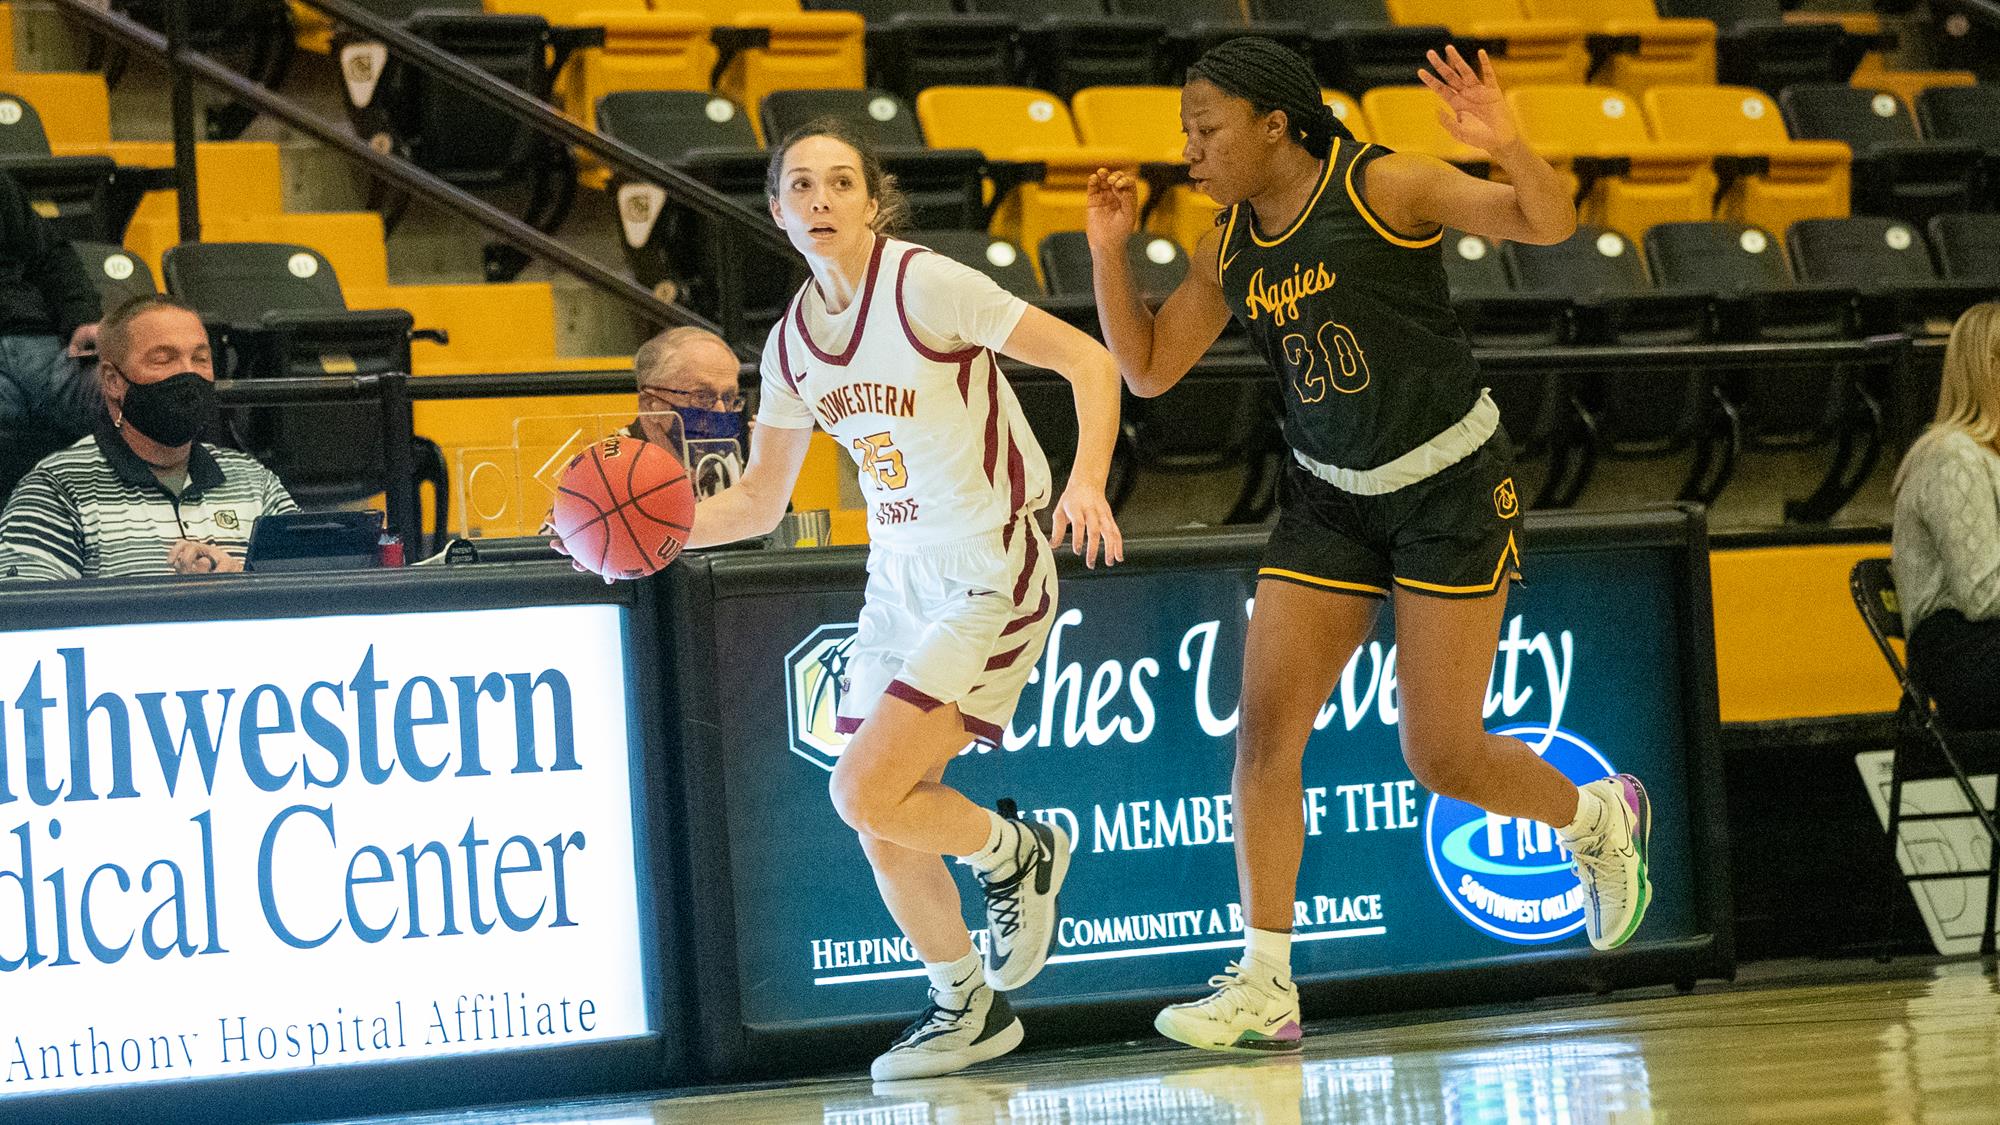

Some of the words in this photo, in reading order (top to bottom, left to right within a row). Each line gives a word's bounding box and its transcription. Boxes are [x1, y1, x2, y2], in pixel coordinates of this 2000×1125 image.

[1245, 261, 1336, 327] Aggies
[1282, 320, 1370, 403] 20
[853, 431, 909, 491] 15
[876, 498, 919, 525] STATE
[0, 643, 583, 806] thwestern
[1092, 793, 1236, 853] MEMBE
[1302, 786, 1327, 836] F
[1335, 779, 1419, 833] THE
[257, 802, 587, 950] Center
[1057, 898, 1204, 948] COMMUNITY
[1207, 898, 1226, 935] A
[1313, 894, 1384, 925] PLACE
[5, 1026, 200, 1083] Anthony
[218, 1000, 407, 1067] Hospital
[424, 990, 598, 1046] Affiliate
